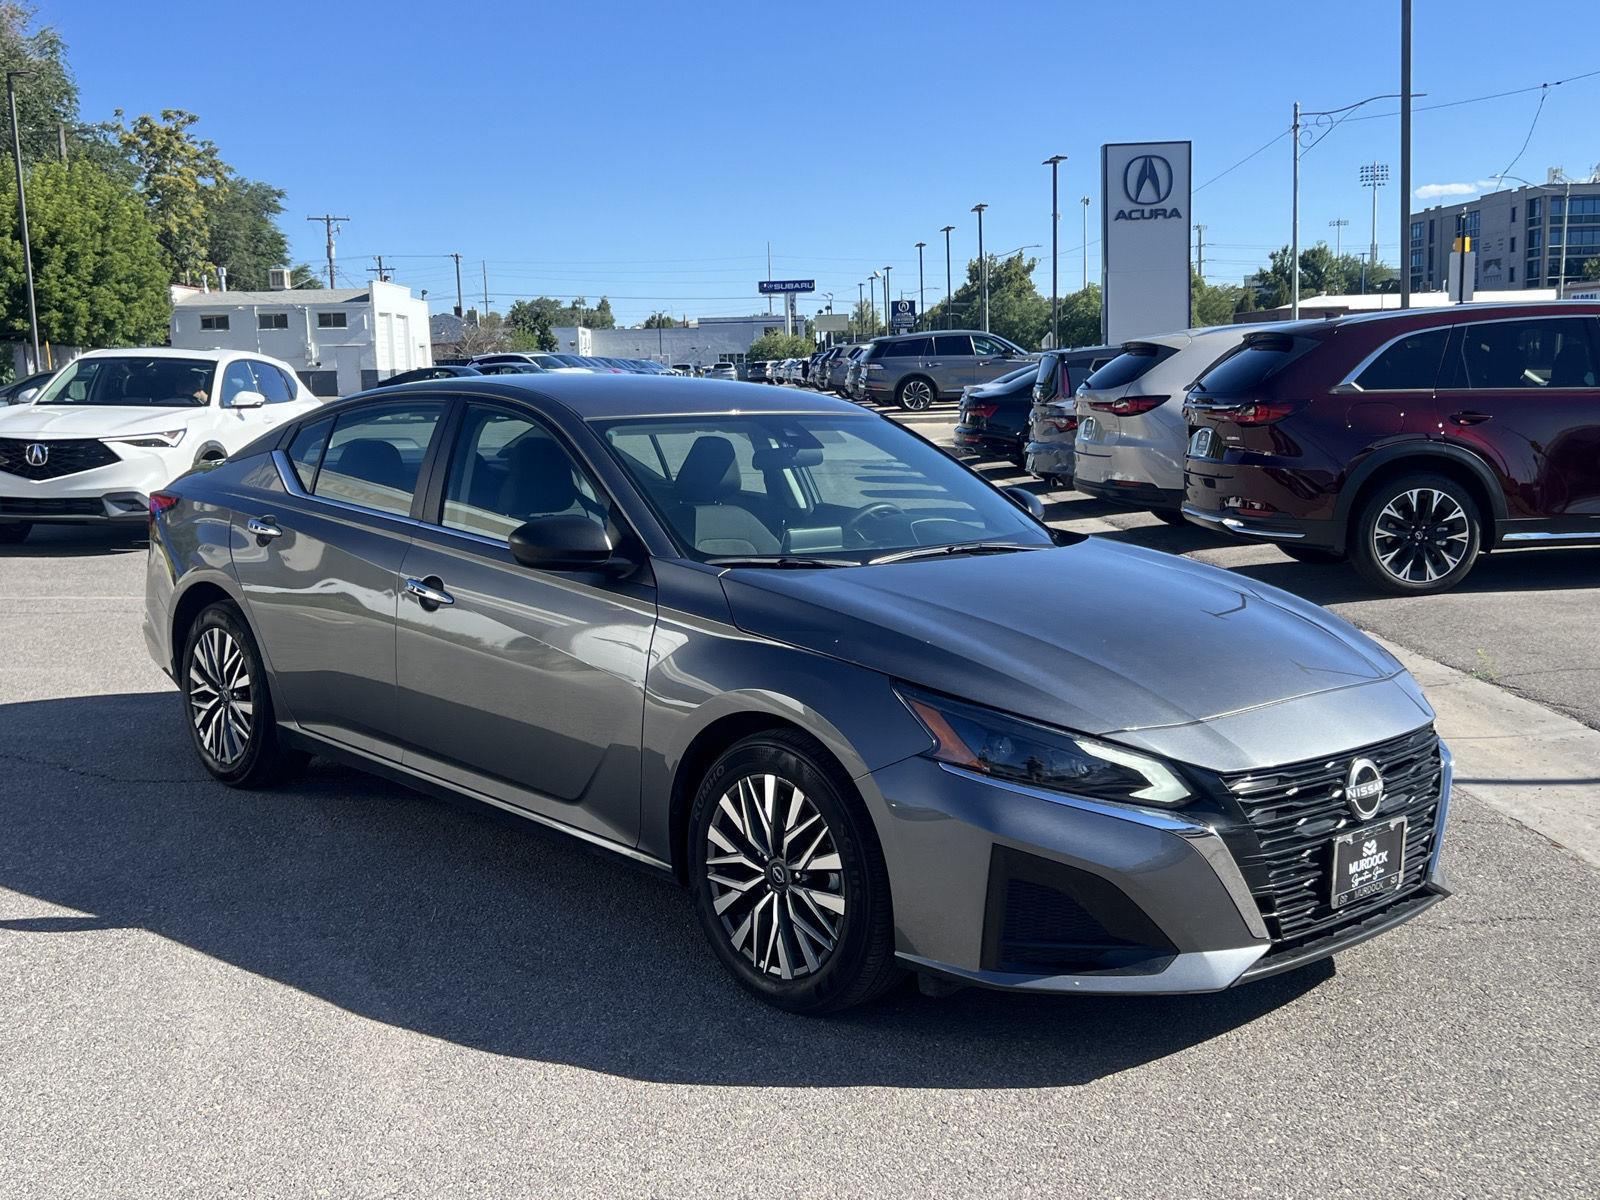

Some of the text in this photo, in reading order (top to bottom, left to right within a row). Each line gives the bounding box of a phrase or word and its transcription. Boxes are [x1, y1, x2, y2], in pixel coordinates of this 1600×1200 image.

[1114, 207, 1182, 221] ACURA
[774, 282, 814, 290] SUBARU
[1346, 780, 1384, 800] NISSAN
[1349, 851, 1388, 875] MURDOCK
[1354, 881, 1384, 899] MURDOCK
